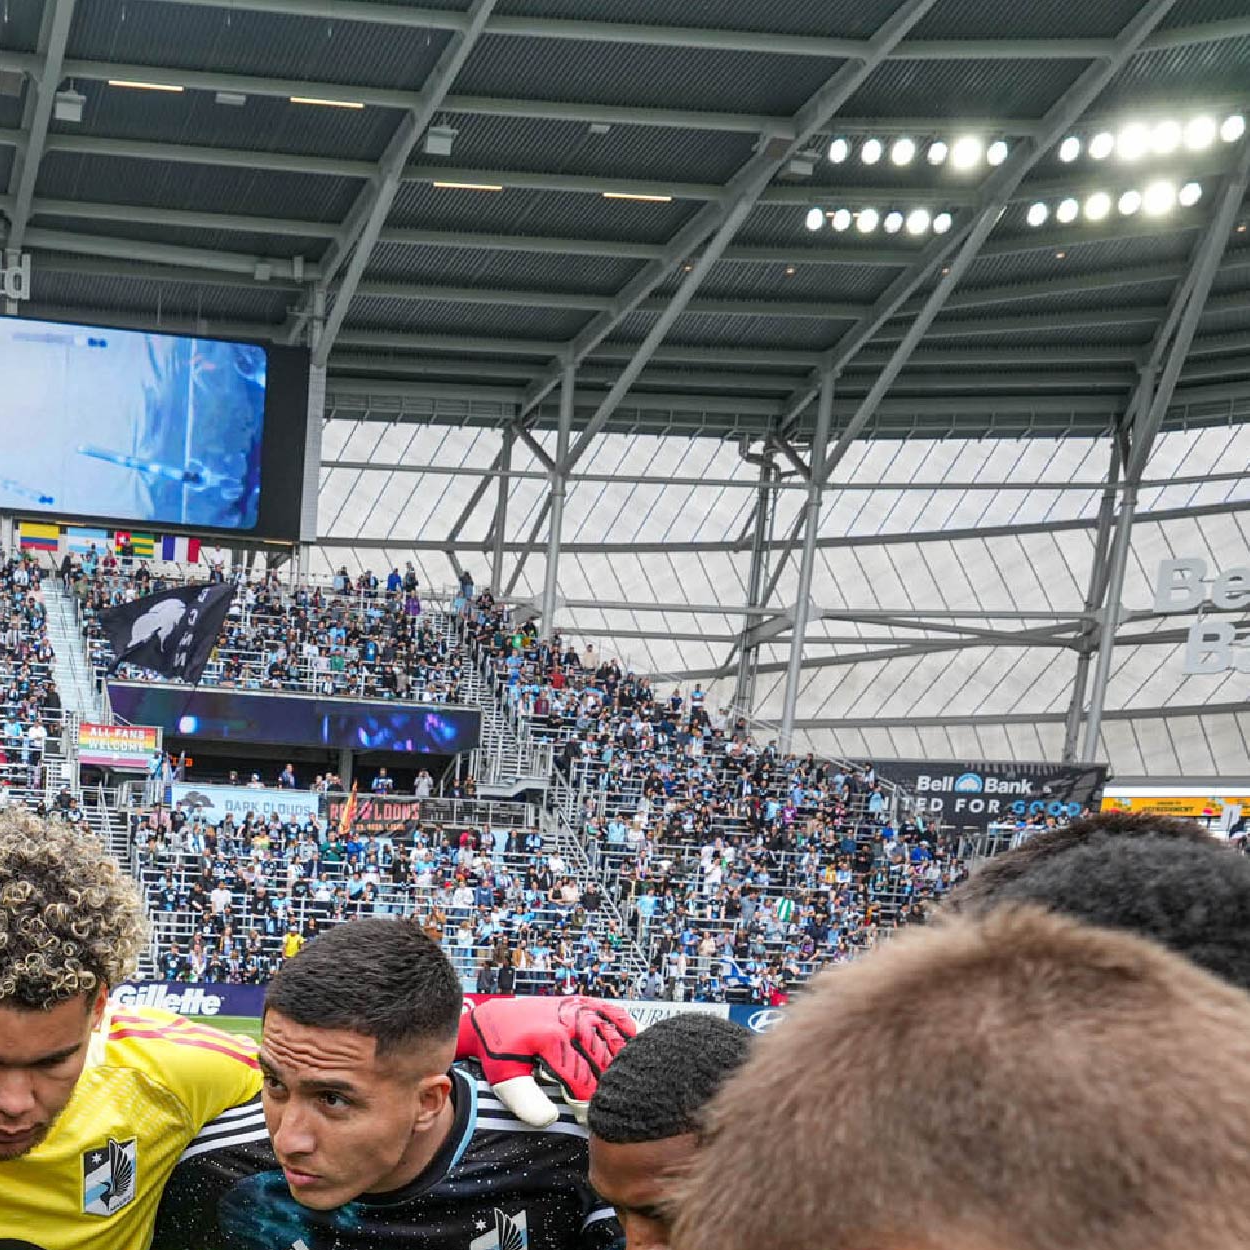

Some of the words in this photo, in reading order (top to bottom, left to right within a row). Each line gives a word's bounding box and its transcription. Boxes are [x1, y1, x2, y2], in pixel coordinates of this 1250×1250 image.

[90, 727, 110, 738] ALL
[115, 729, 146, 739] FANS
[88, 739, 146, 751] WELCOME
[917, 775, 954, 792] Bell
[984, 776, 1033, 794] Bank
[225, 800, 260, 812] DARK
[263, 802, 310, 816] CLOUDS
[374, 802, 421, 820] LOONS
[955, 798, 1000, 813] FOR
[1012, 800, 1081, 817] GOOD
[112, 984, 222, 1015] Gillette
